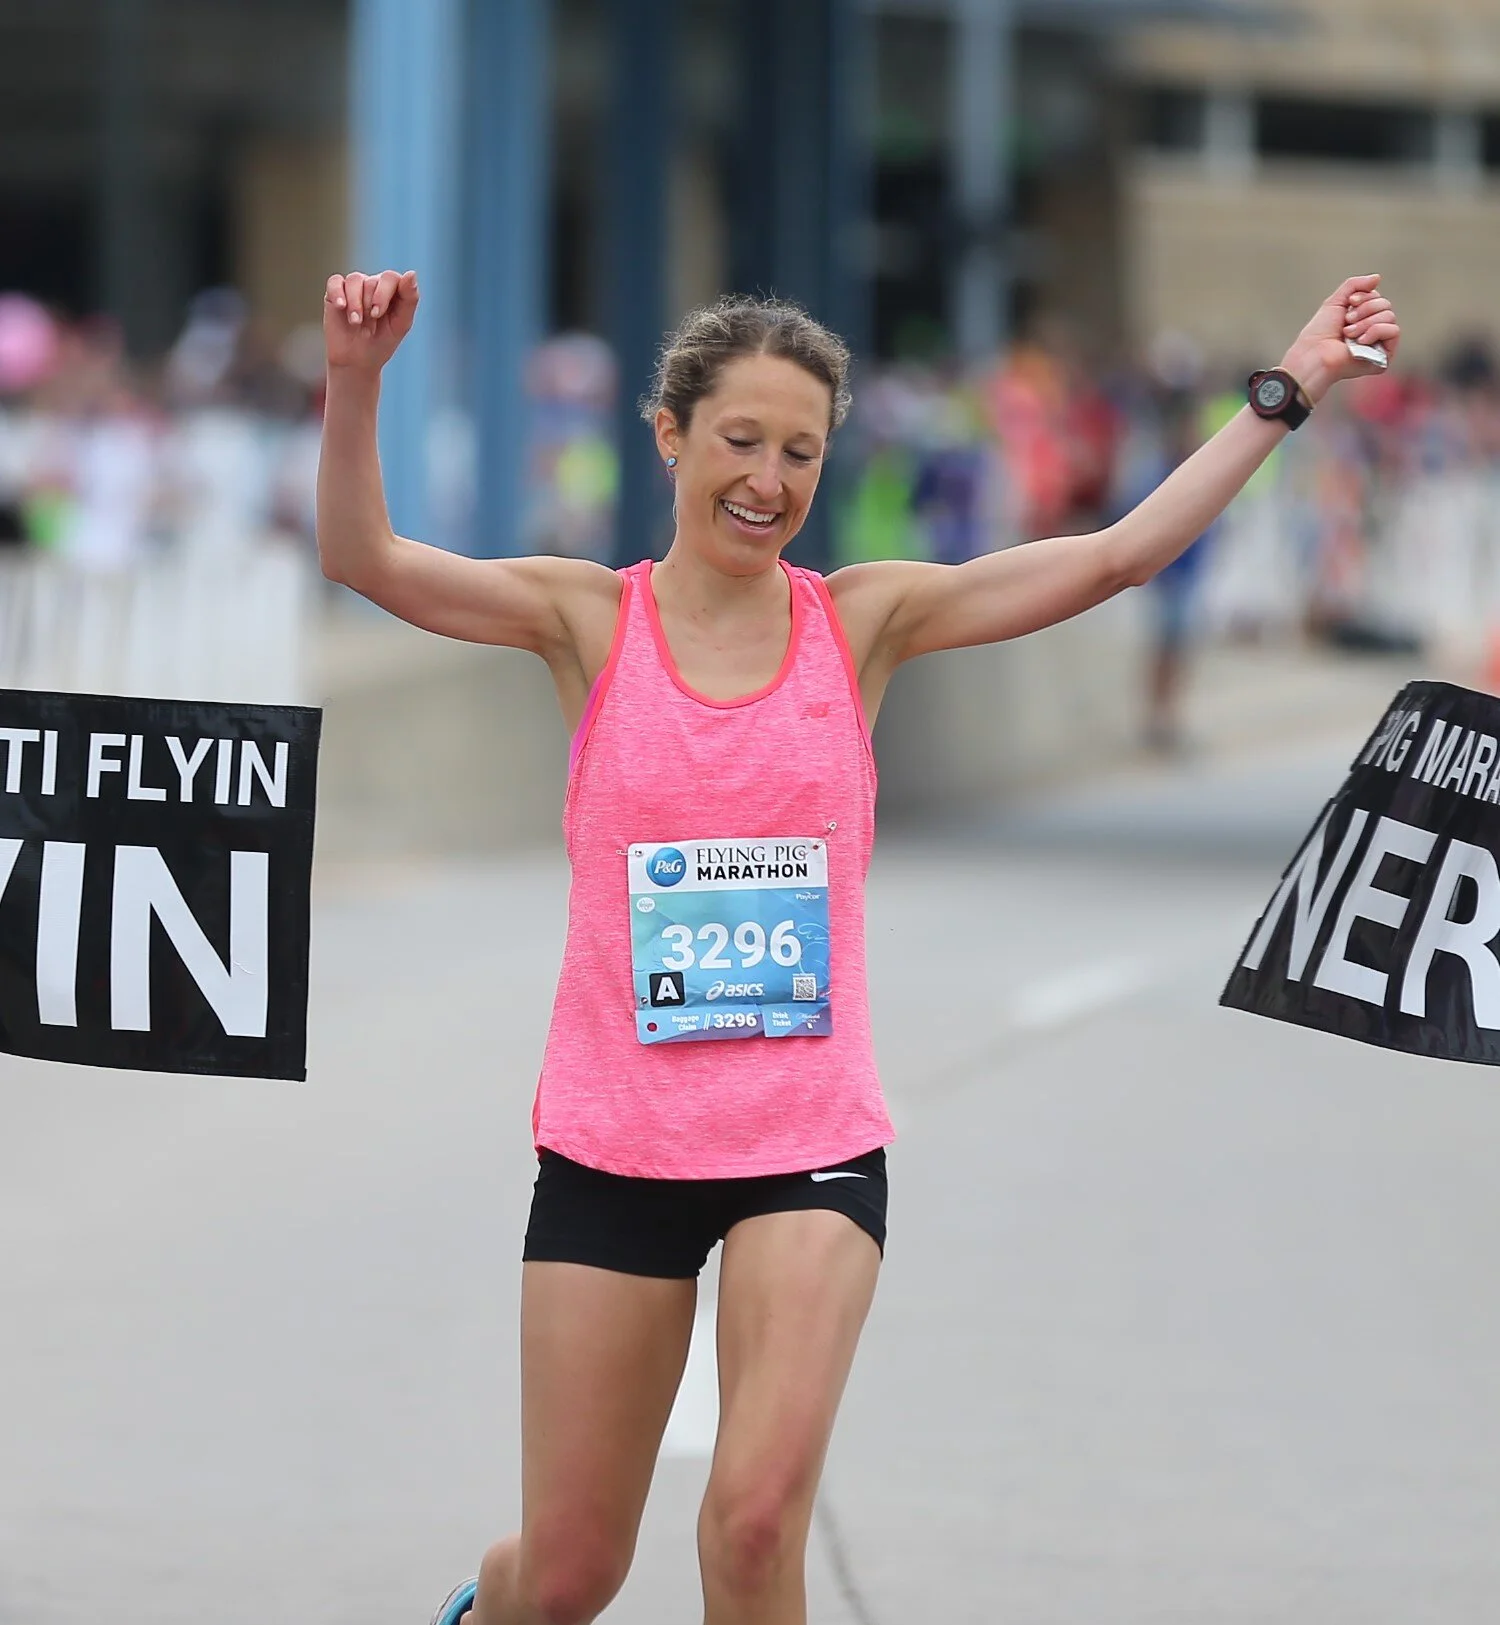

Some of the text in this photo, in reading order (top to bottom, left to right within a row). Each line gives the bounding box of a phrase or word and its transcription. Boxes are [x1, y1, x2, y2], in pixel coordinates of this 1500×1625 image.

[1361, 710, 1420, 772] PIG
[0, 728, 289, 808] TI FLYIN
[696, 845, 808, 864] FLYING PIG
[654, 859, 682, 874] P&G
[697, 863, 808, 881] MARATHON
[1242, 803, 1500, 1030] NER
[661, 920, 802, 970] 3296
[656, 976, 680, 1001] A
[724, 983, 764, 997] asics
[713, 1012, 757, 1029] 3296
